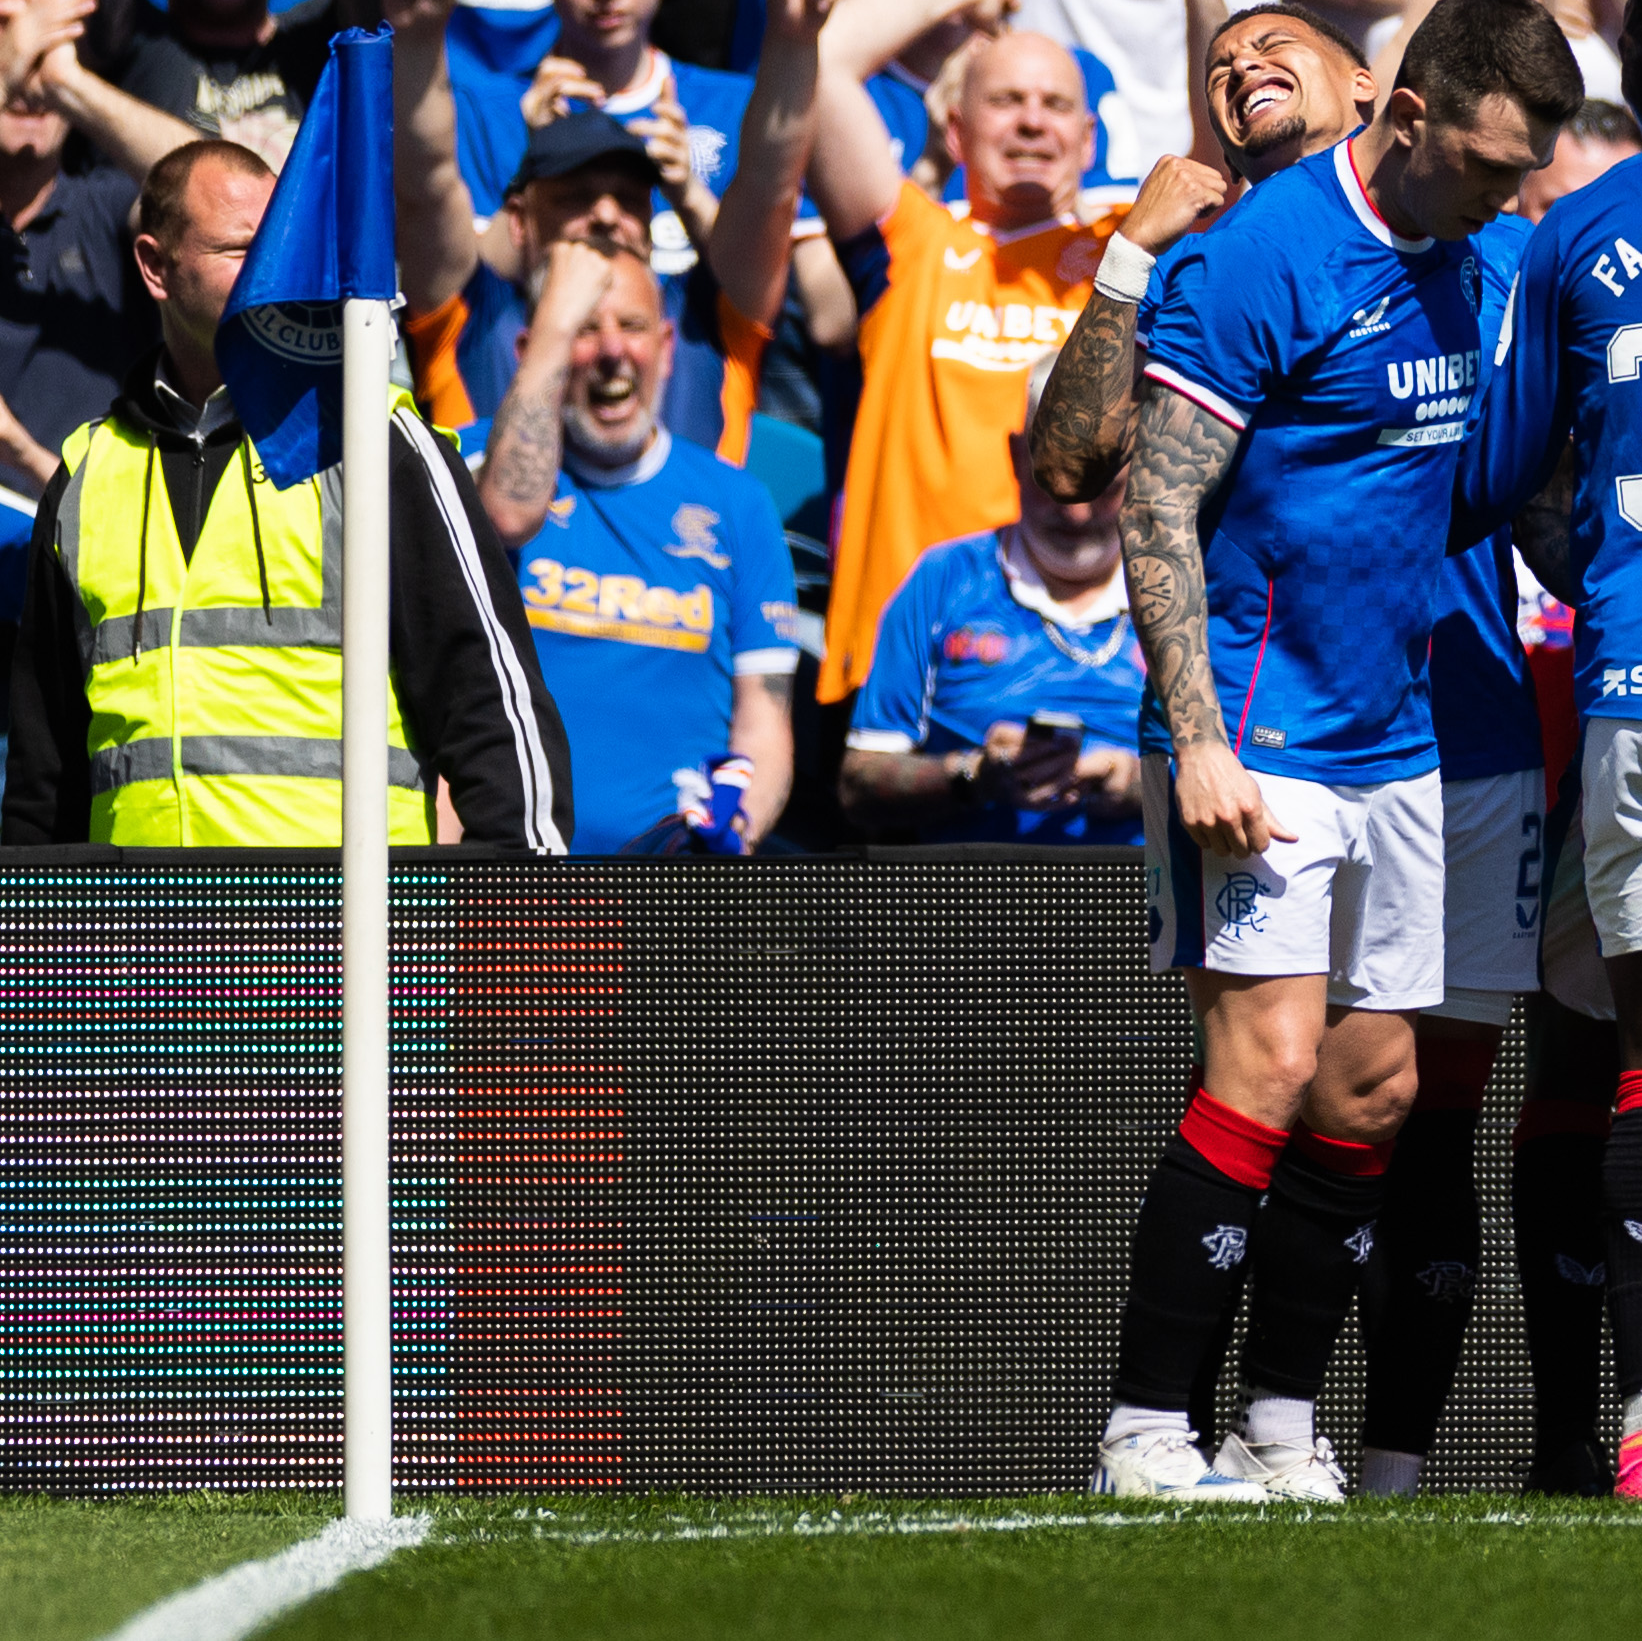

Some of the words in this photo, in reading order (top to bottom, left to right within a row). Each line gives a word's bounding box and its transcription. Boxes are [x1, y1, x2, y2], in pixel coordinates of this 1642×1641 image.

[277, 324, 341, 351] CLUB
[1406, 430, 1424, 443] SET
[1426, 427, 1449, 441] YOUR
[524, 558, 714, 629] 32Red
